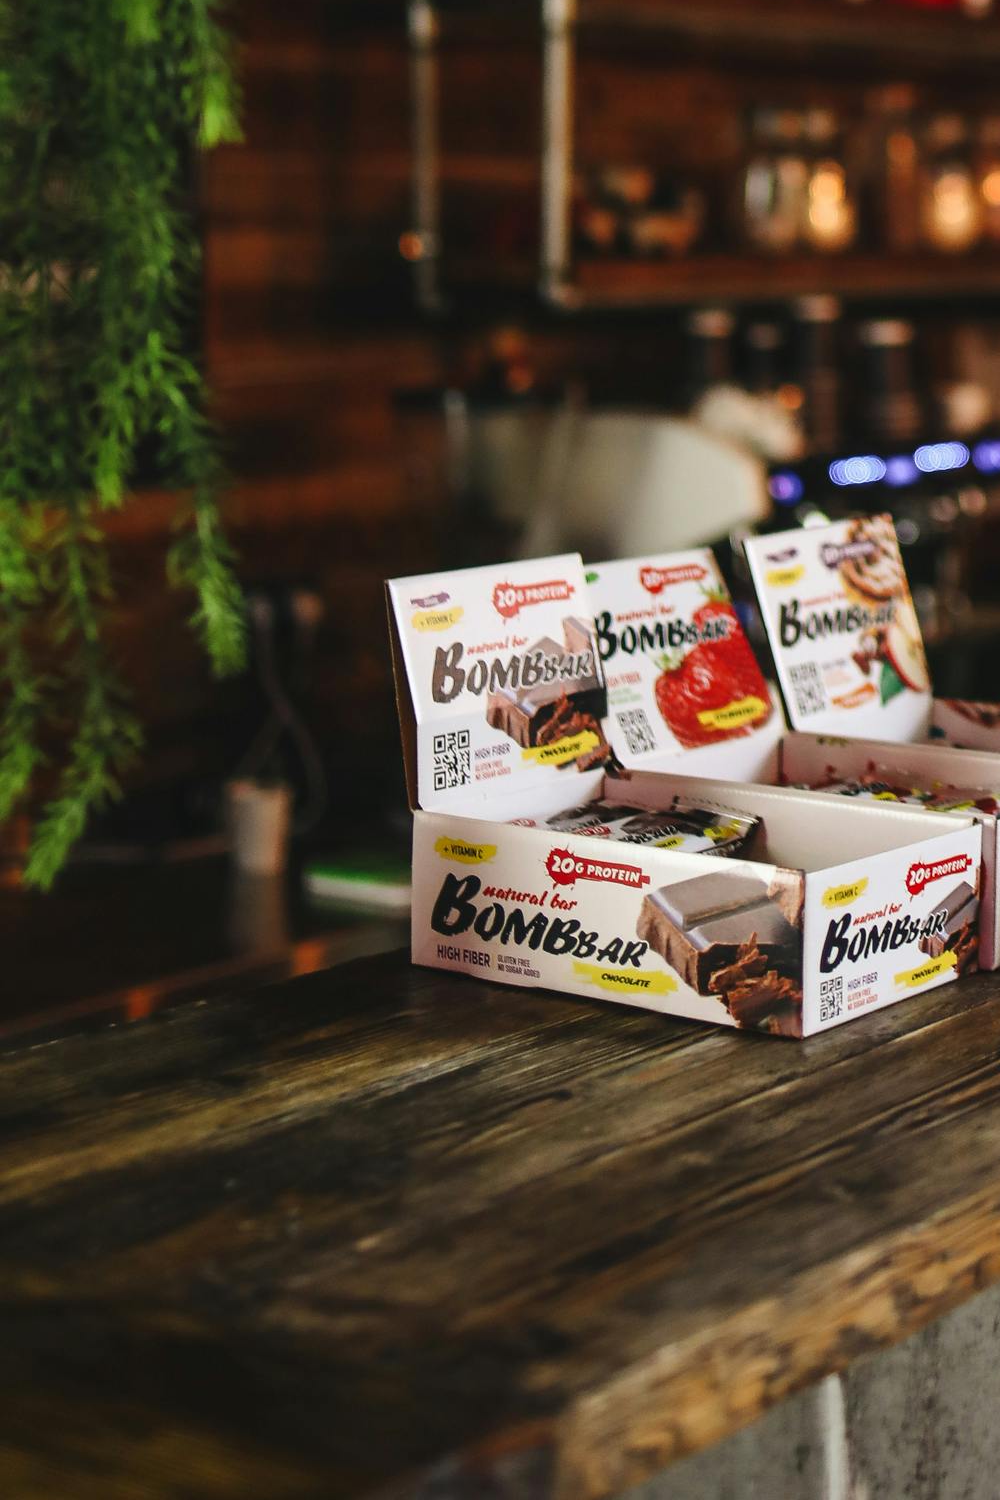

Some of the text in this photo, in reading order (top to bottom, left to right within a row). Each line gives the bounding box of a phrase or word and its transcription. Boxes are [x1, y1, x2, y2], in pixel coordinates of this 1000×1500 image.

[525, 584, 568, 602] PROTEIN
[466, 636, 510, 655] natural
[595, 610, 730, 661] BOMBBAR
[431, 641, 595, 704] BOMBBAR
[451, 843, 477, 859] VITAMIN
[477, 849, 483, 859] C
[551, 854, 640, 883] 20G PROTEIN
[909, 859, 966, 886] 20G PROTEIN
[482, 885, 578, 911] natural bar
[834, 890, 854, 901] VITAMIN
[431, 872, 649, 968] BOMBBAR
[853, 903, 903, 926] natural bar
[819, 909, 948, 974] BOMBBAR
[437, 944, 491, 968] HIGH FIBER
[497, 955, 531, 968] GLUTEN FREE
[505, 964, 523, 976] SUGAR
[523, 967, 540, 978] ADDED
[601, 972, 651, 988] CHOCOLATE
[847, 972, 878, 991] HIGH FIBER
